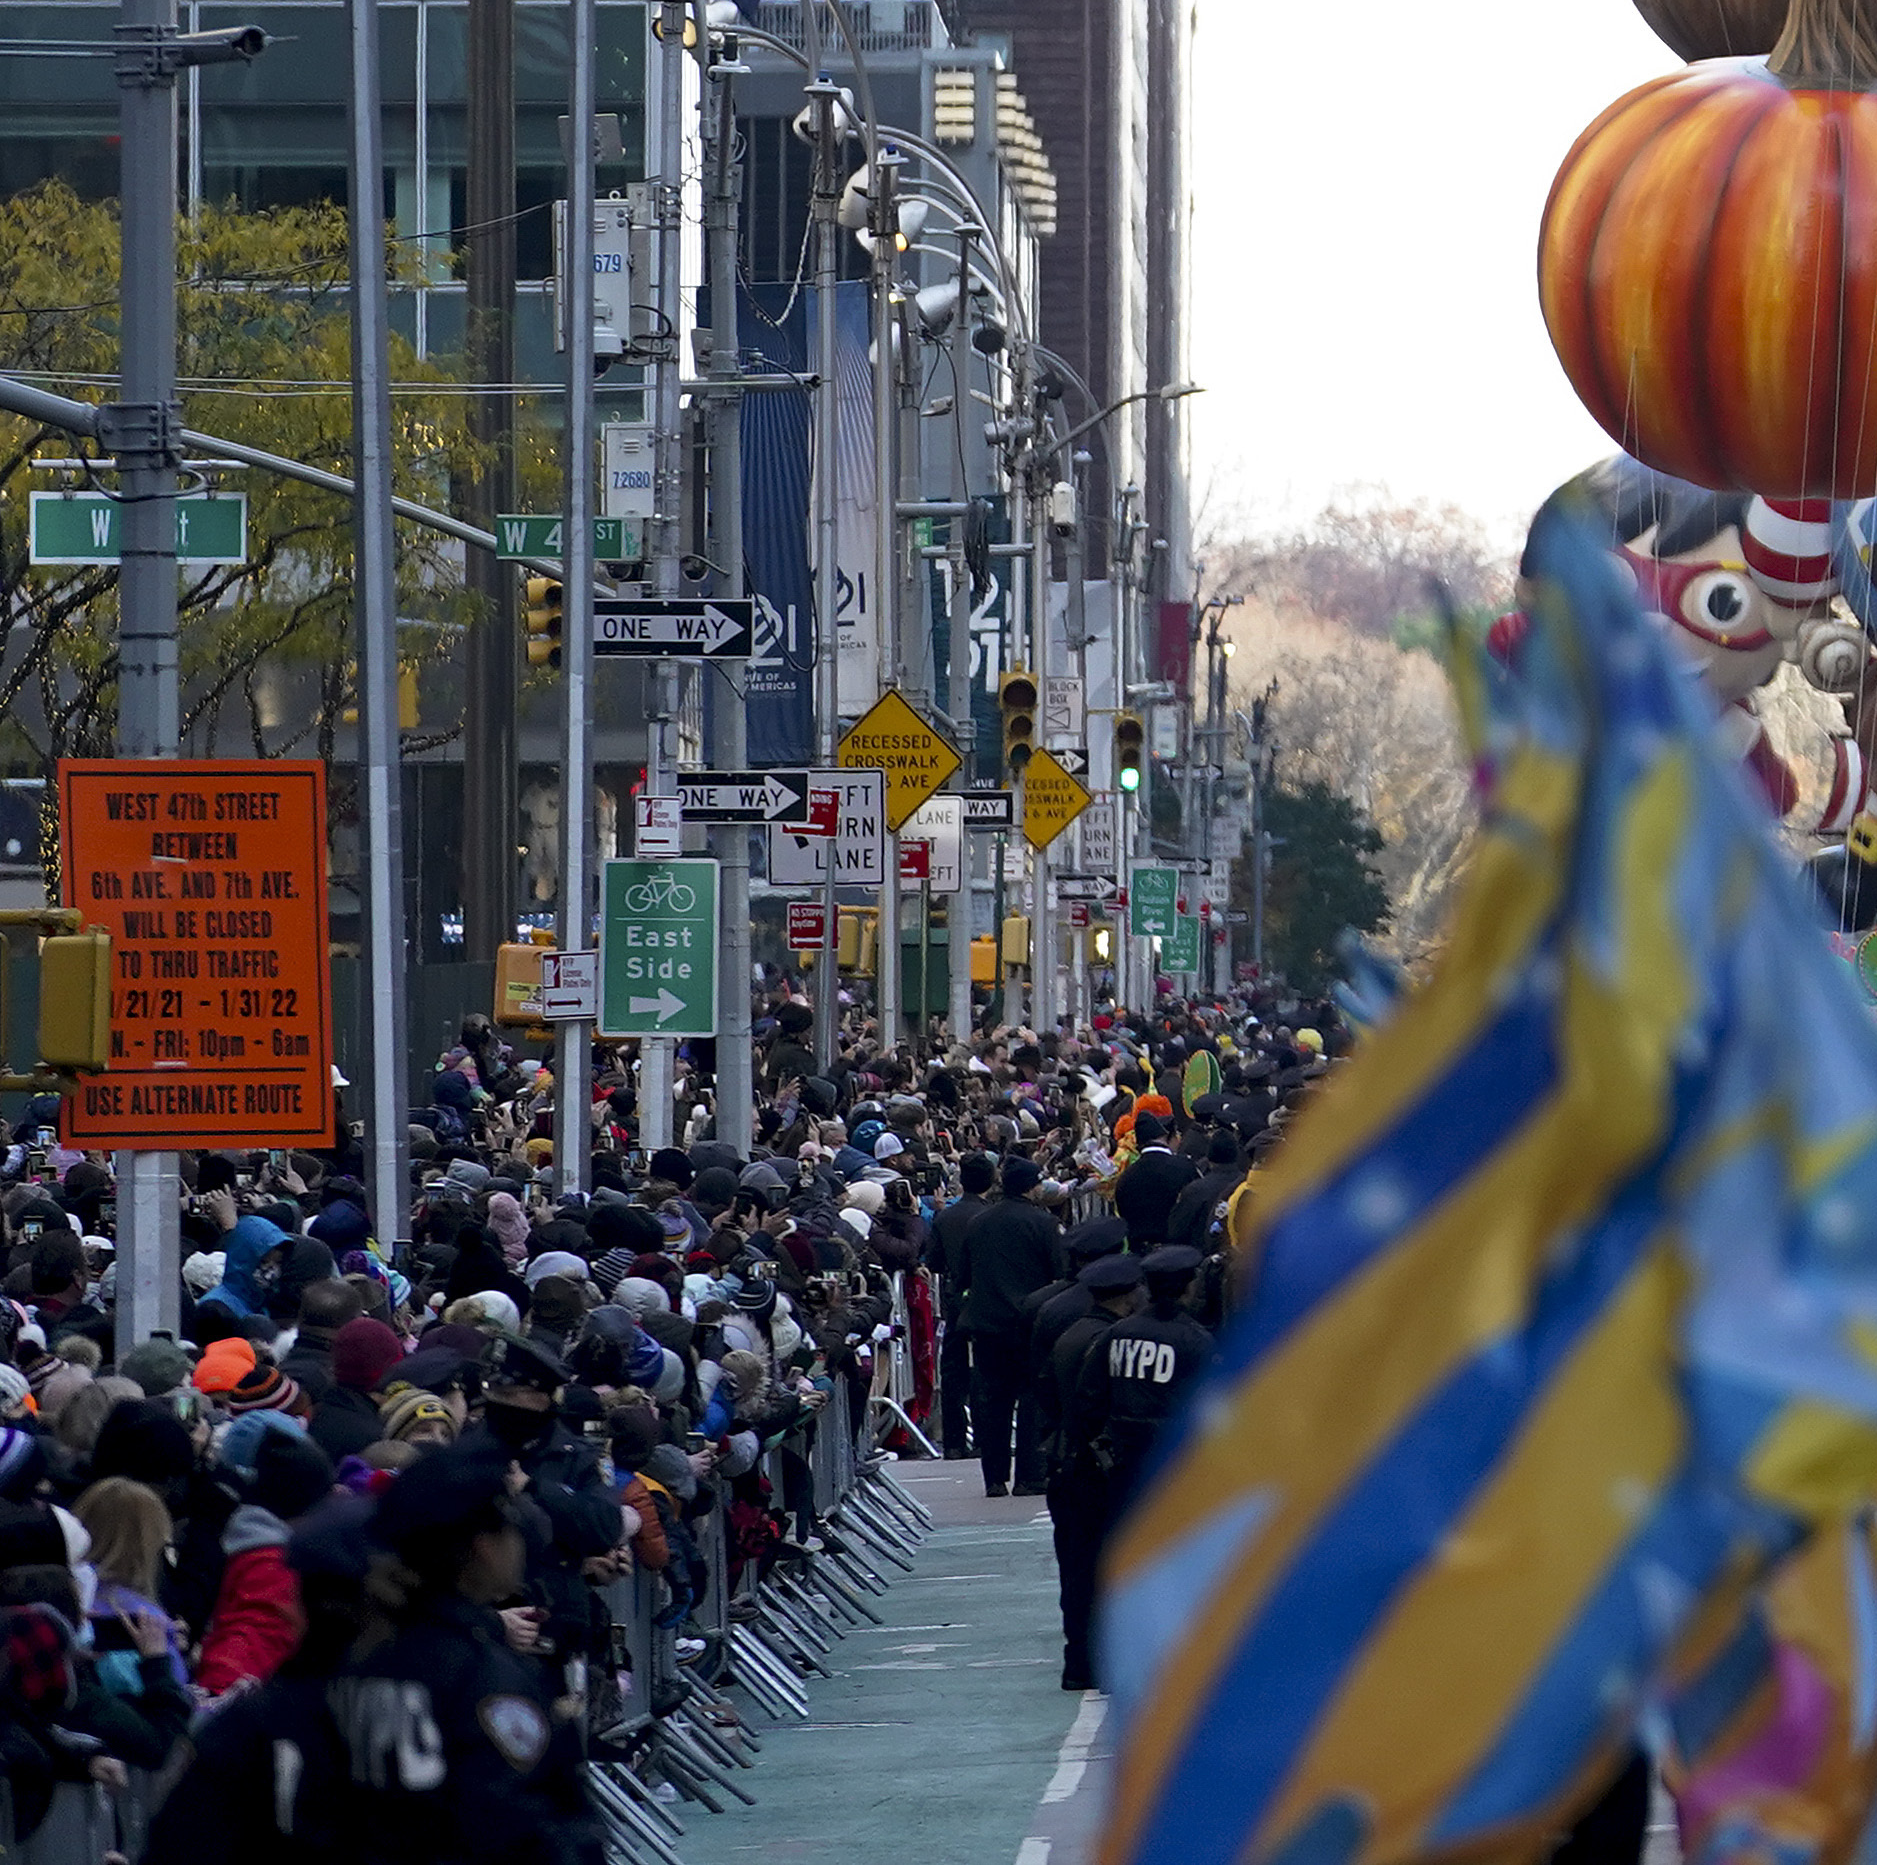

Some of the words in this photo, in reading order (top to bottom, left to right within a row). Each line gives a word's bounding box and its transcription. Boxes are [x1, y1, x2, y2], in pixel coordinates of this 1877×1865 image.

[91, 509, 111, 547] W
[504, 521, 527, 553] W
[544, 522, 563, 553] 4
[596, 523, 617, 540] ST
[604, 619, 651, 639] ONE
[676, 619, 727, 639] WAY
[752, 681, 797, 691] MERICAS
[851, 736, 931, 749] RECESSED
[845, 755, 939, 768] CROSSWALK
[1057, 756, 1075, 768] AY
[900, 776, 930, 789] AVE
[1025, 779, 1070, 790] CESSED
[106, 792, 158, 821] WEST
[168, 792, 208, 820] 47th
[215, 792, 281, 820] STREET
[677, 788, 717, 806] ONE
[740, 789, 784, 806] WAY
[917, 811, 953, 825] LANE
[968, 802, 999, 815] WAY
[1084, 829, 1111, 842] URN
[152, 832, 238, 861] BETWEEN
[1085, 846, 1111, 860] ANE
[929, 866, 954, 880] EFT
[91, 872, 123, 900] 6th
[132, 872, 173, 900] AVE.
[181, 872, 216, 899] AND
[224, 872, 253, 899] 7th
[262, 871, 300, 899] AVE.
[123, 911, 165, 938] WILL
[175, 911, 197, 938] BE
[205, 911, 272, 939] CLOSED
[626, 925, 692, 948] East
[119, 951, 142, 979] TO
[151, 951, 198, 979] THRU
[208, 950, 280, 978] TRAFFIC
[626, 957, 693, 979] Side
[221, 989, 298, 1018] 1/31/22
[272, 1028, 310, 1057] 6am
[85, 1085, 123, 1117] USE
[131, 1084, 238, 1115] ALTERNATE
[244, 1083, 303, 1114] ROUTE
[1109, 1338, 1176, 1384] NYPD
